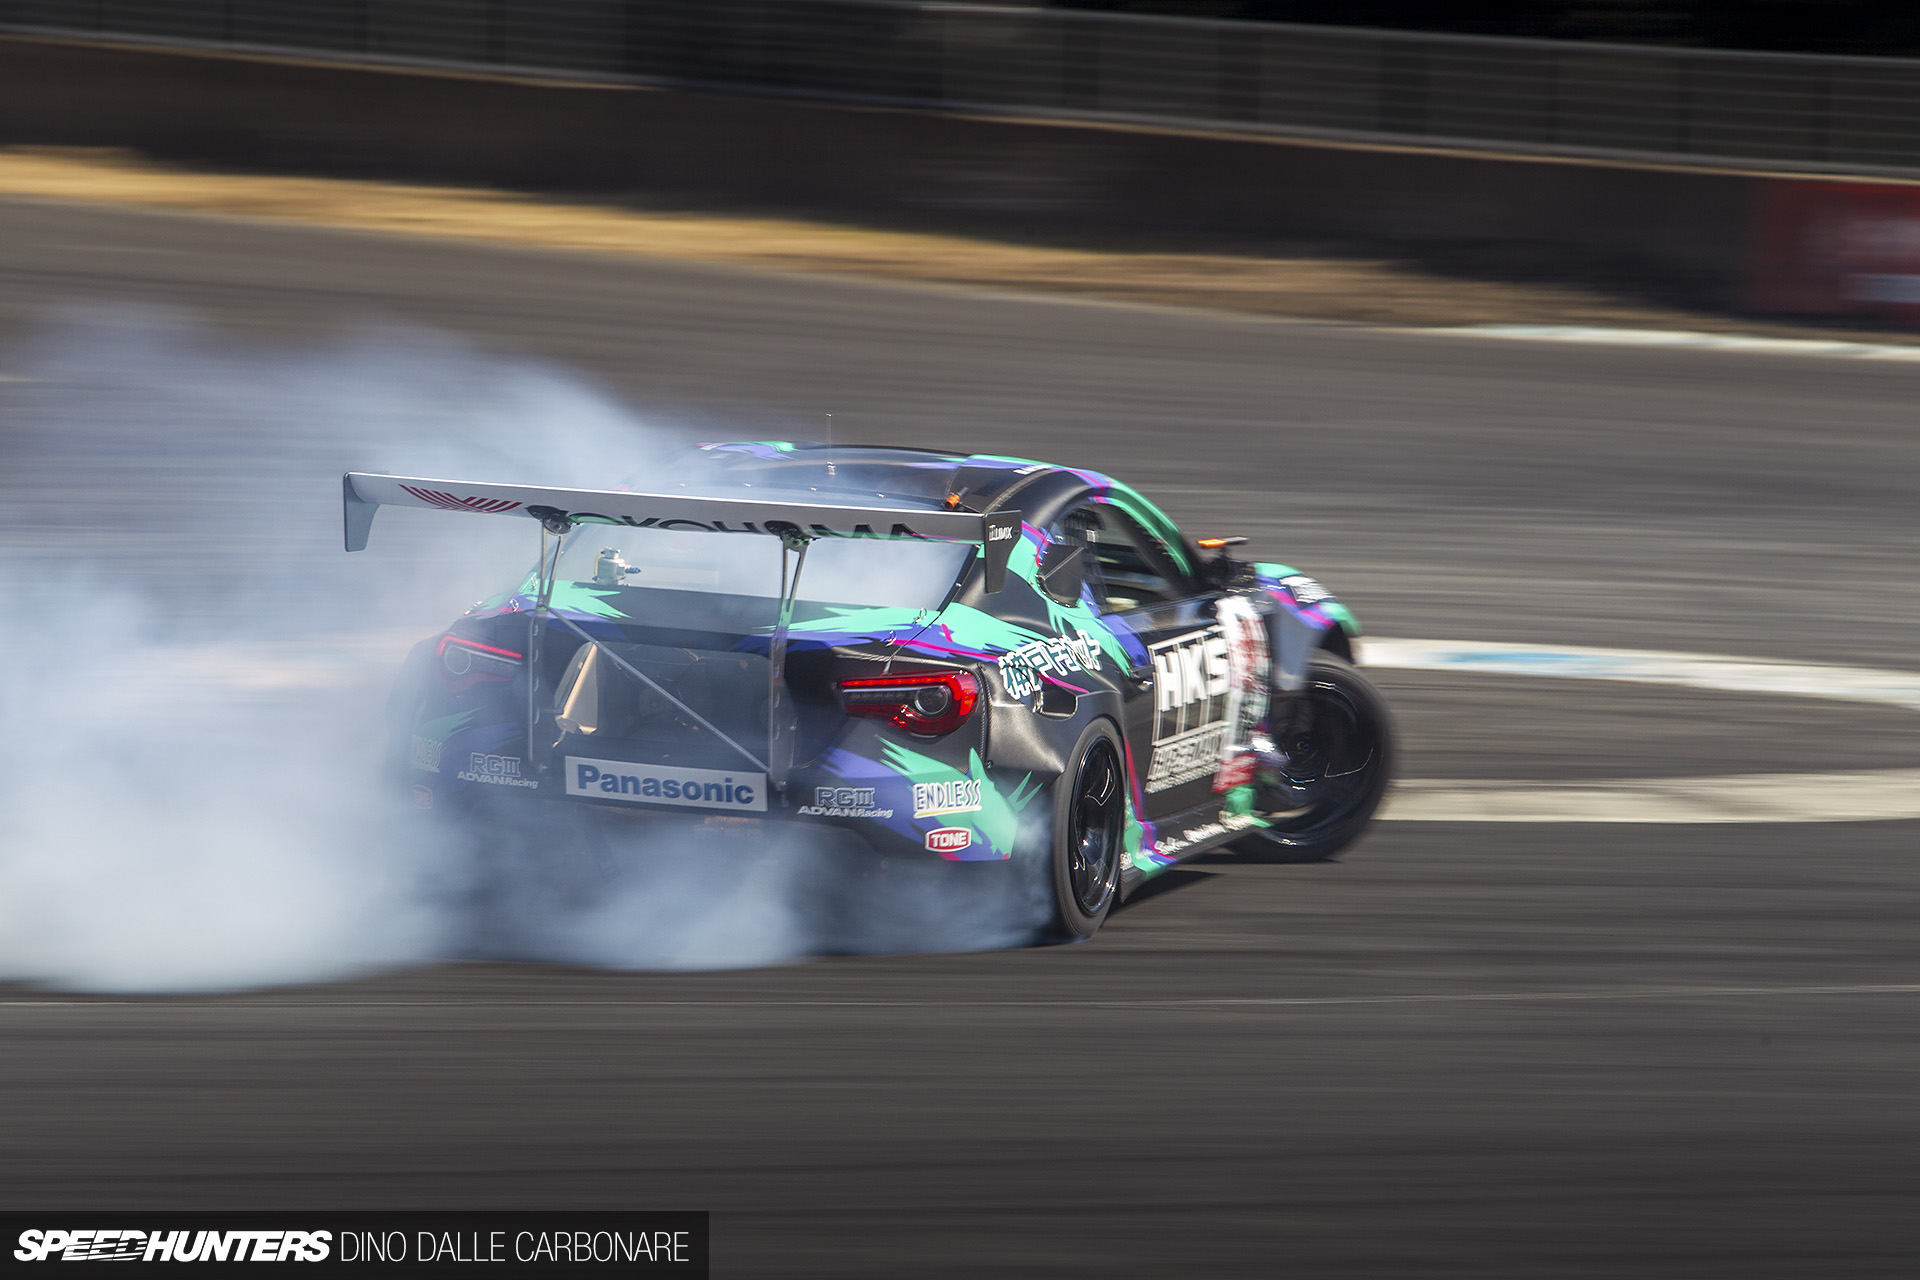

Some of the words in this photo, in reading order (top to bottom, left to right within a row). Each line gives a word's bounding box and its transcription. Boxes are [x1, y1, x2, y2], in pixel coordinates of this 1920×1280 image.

[1155, 637, 1231, 712] HKS
[457, 771, 505, 785] ADVAN
[505, 777, 539, 790] Racing
[577, 763, 755, 805] Panasonic
[913, 779, 982, 813] ENDLESS
[797, 805, 857, 818] ADVAN
[857, 808, 894, 819] Racing
[930, 831, 969, 848] TONE
